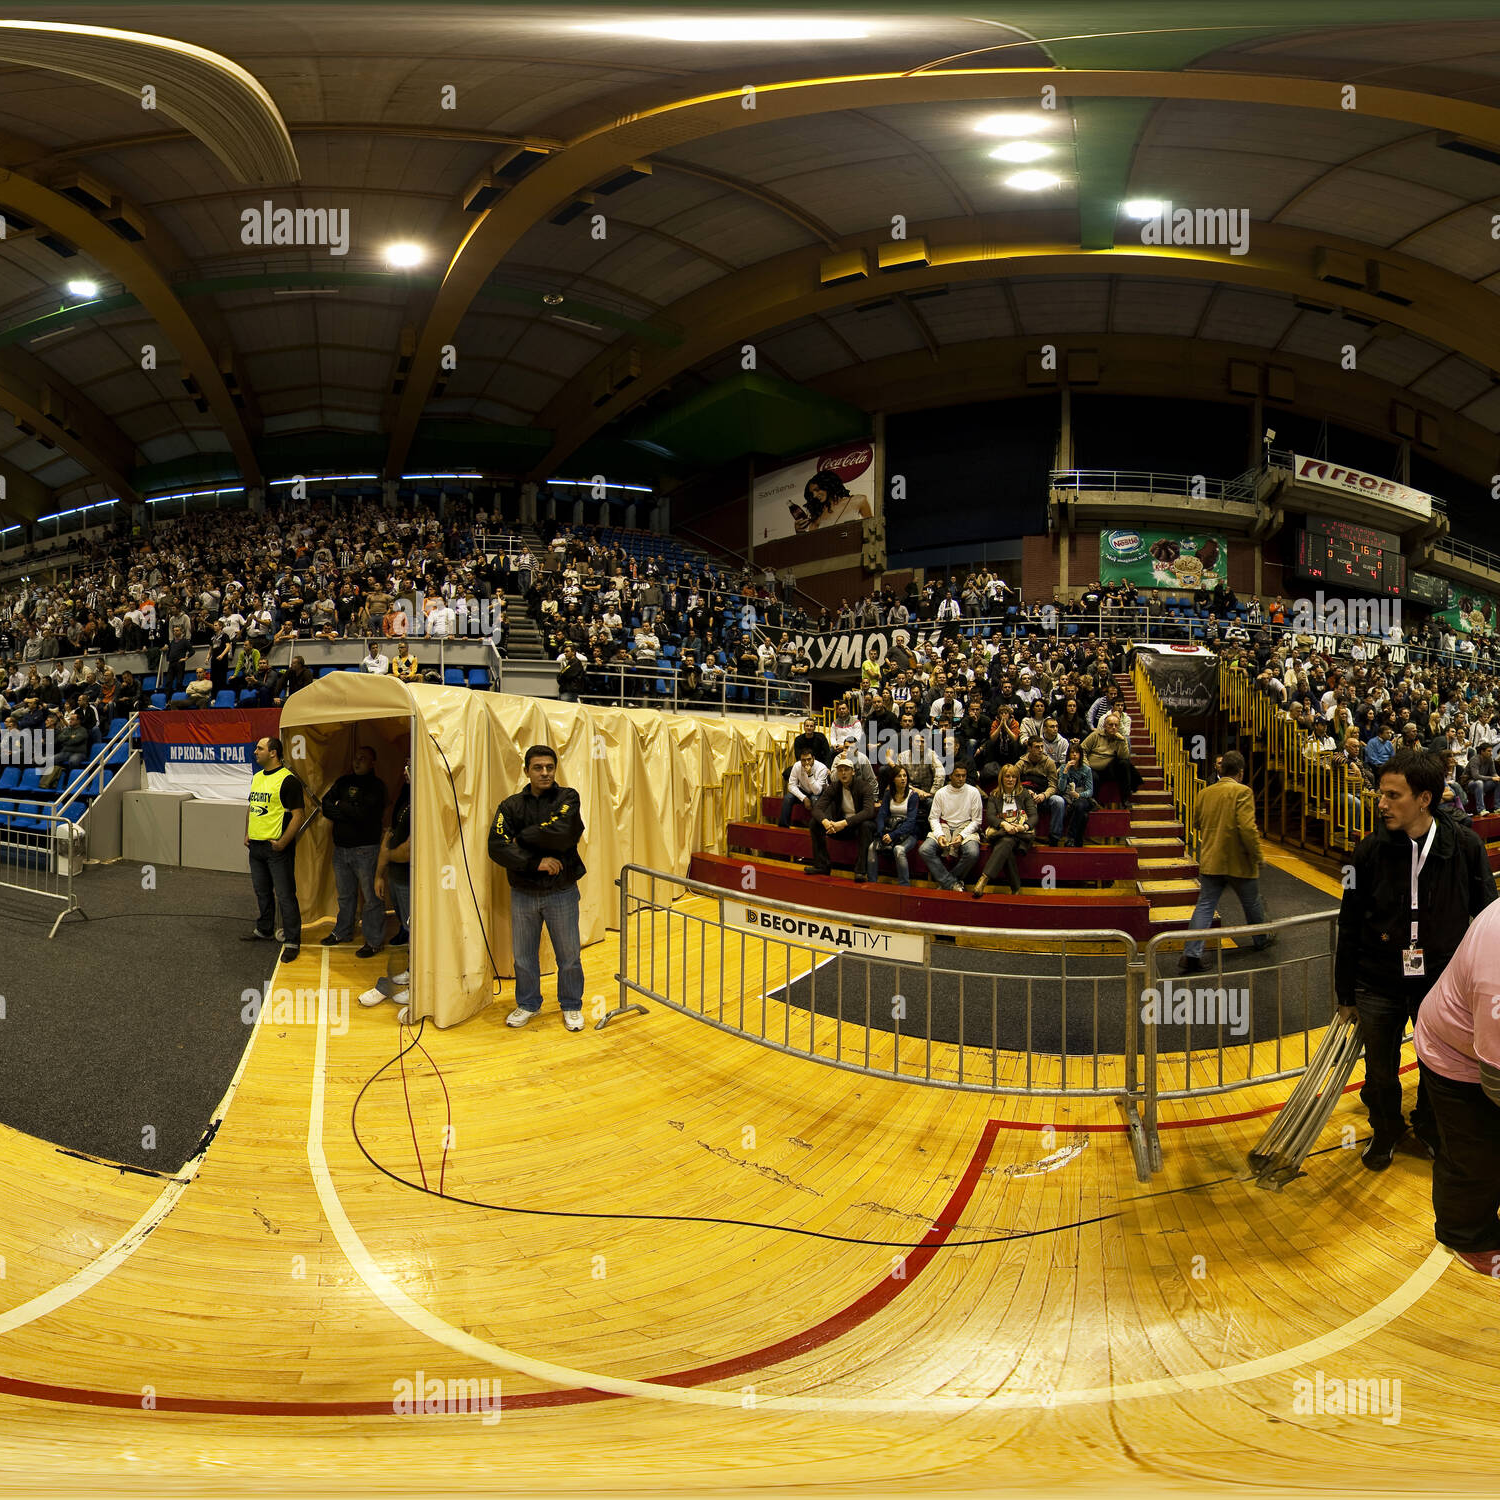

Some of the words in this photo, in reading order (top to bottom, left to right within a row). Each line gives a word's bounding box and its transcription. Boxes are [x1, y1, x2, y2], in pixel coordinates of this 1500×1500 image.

[820, 449, 869, 471] Coca-Cola
[220, 746, 246, 762] ГРАД
[760, 912, 892, 951] БЕОГРАДПУТ
